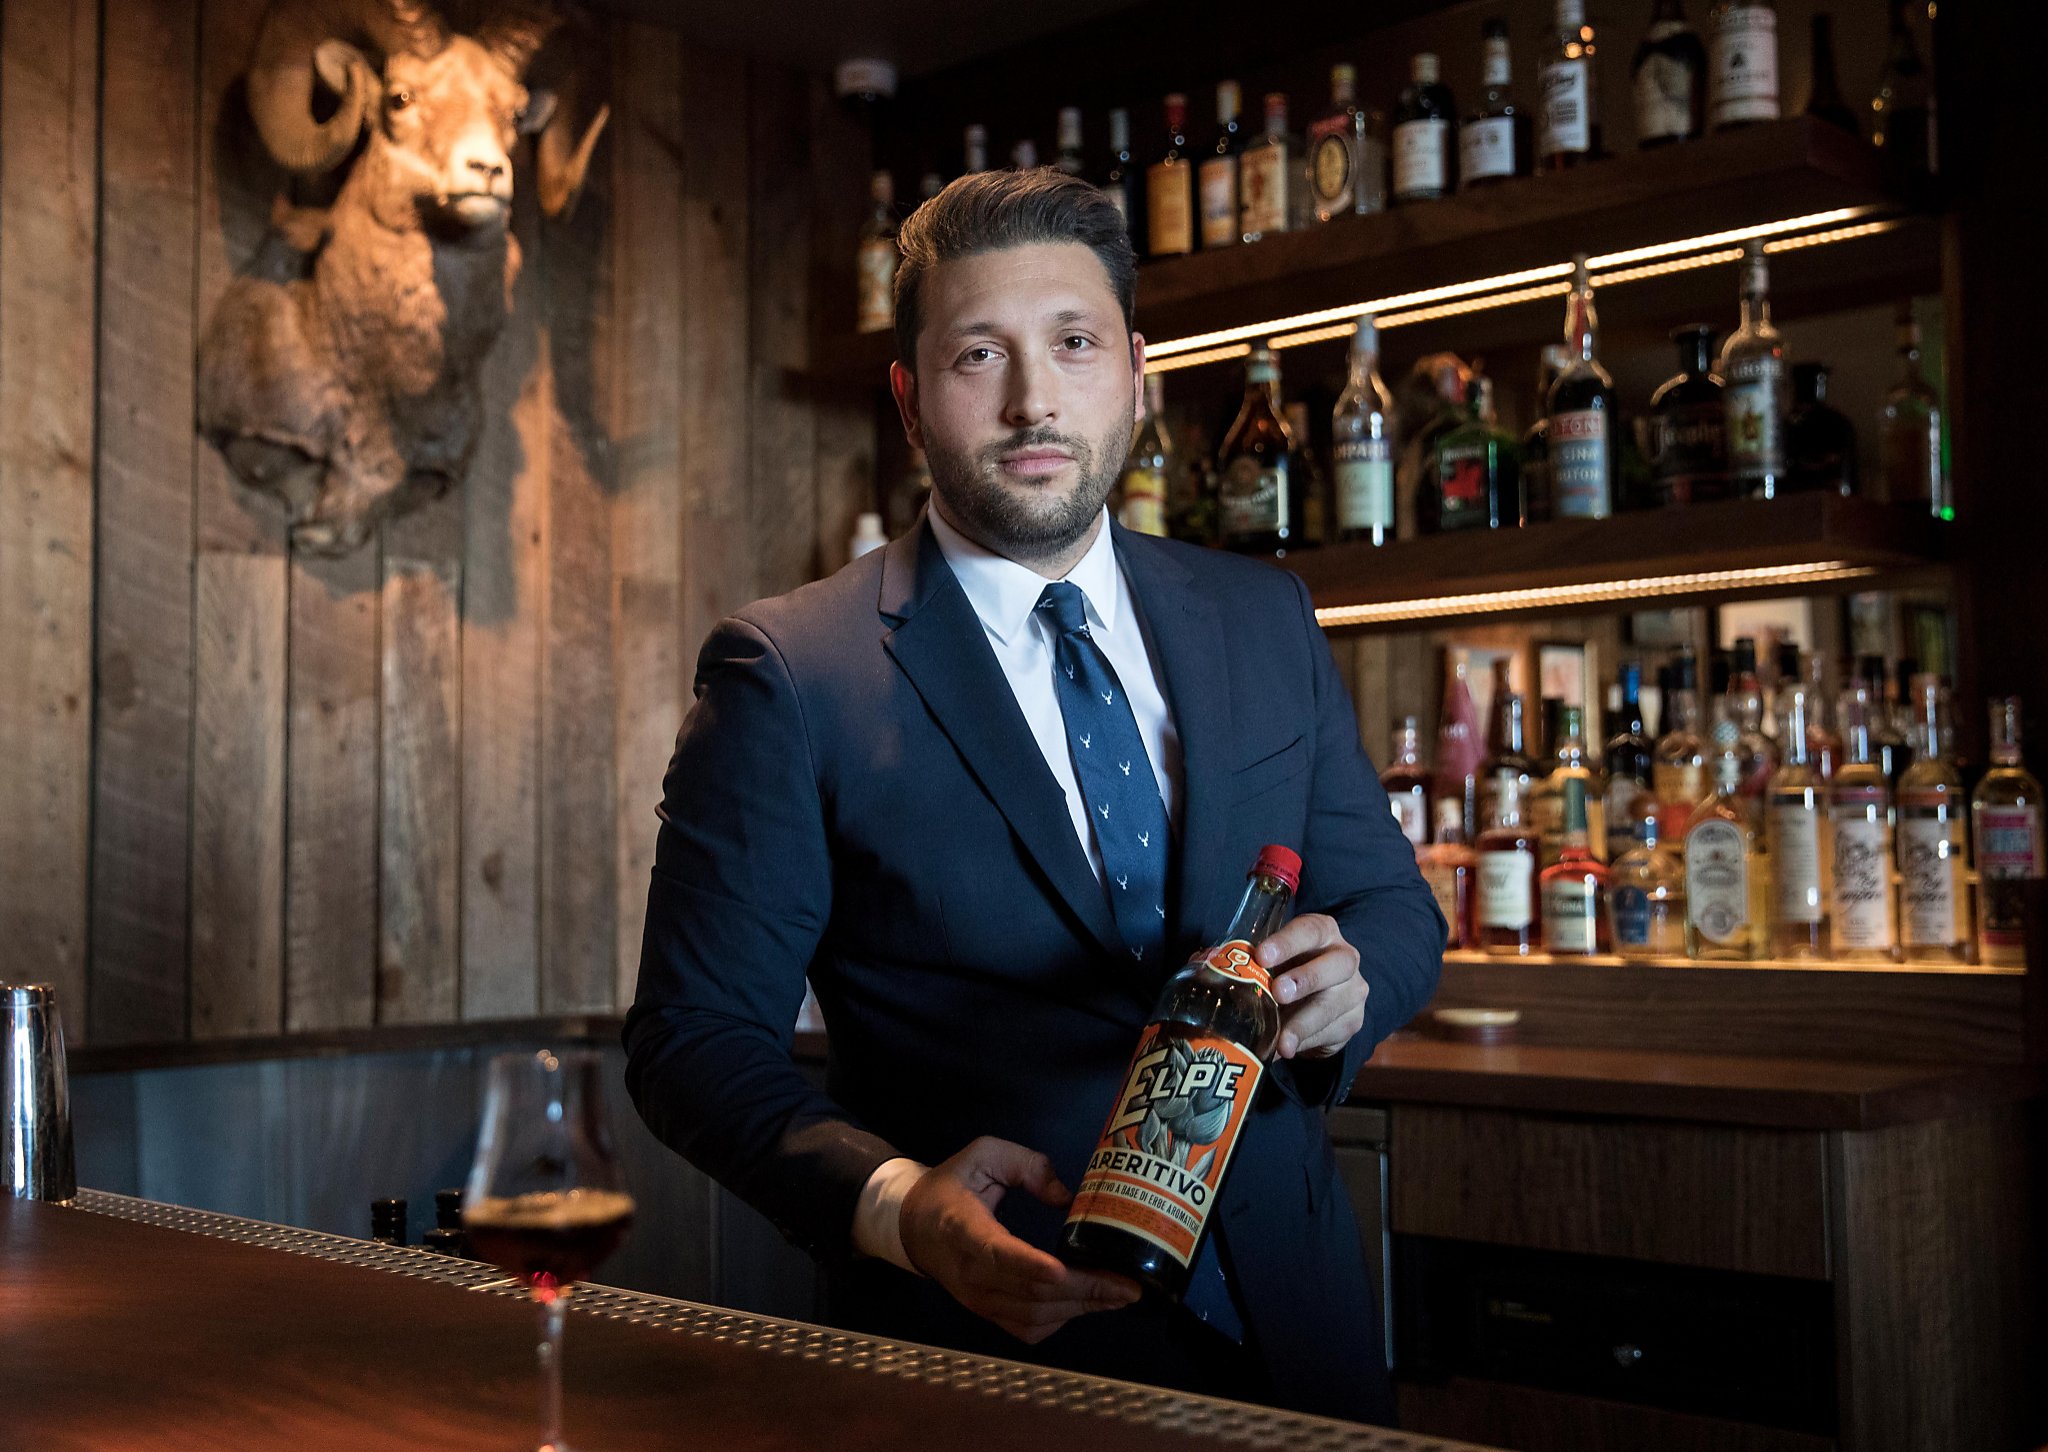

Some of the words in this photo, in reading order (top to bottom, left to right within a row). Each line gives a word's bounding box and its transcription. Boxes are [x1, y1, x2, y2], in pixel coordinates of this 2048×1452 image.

[1106, 1047, 1246, 1138] ELPE
[1088, 1151, 1206, 1206] APERITIVO
[1115, 1184, 1120, 1194] A
[1121, 1185, 1138, 1199] BASE
[1138, 1190, 1149, 1202] DI
